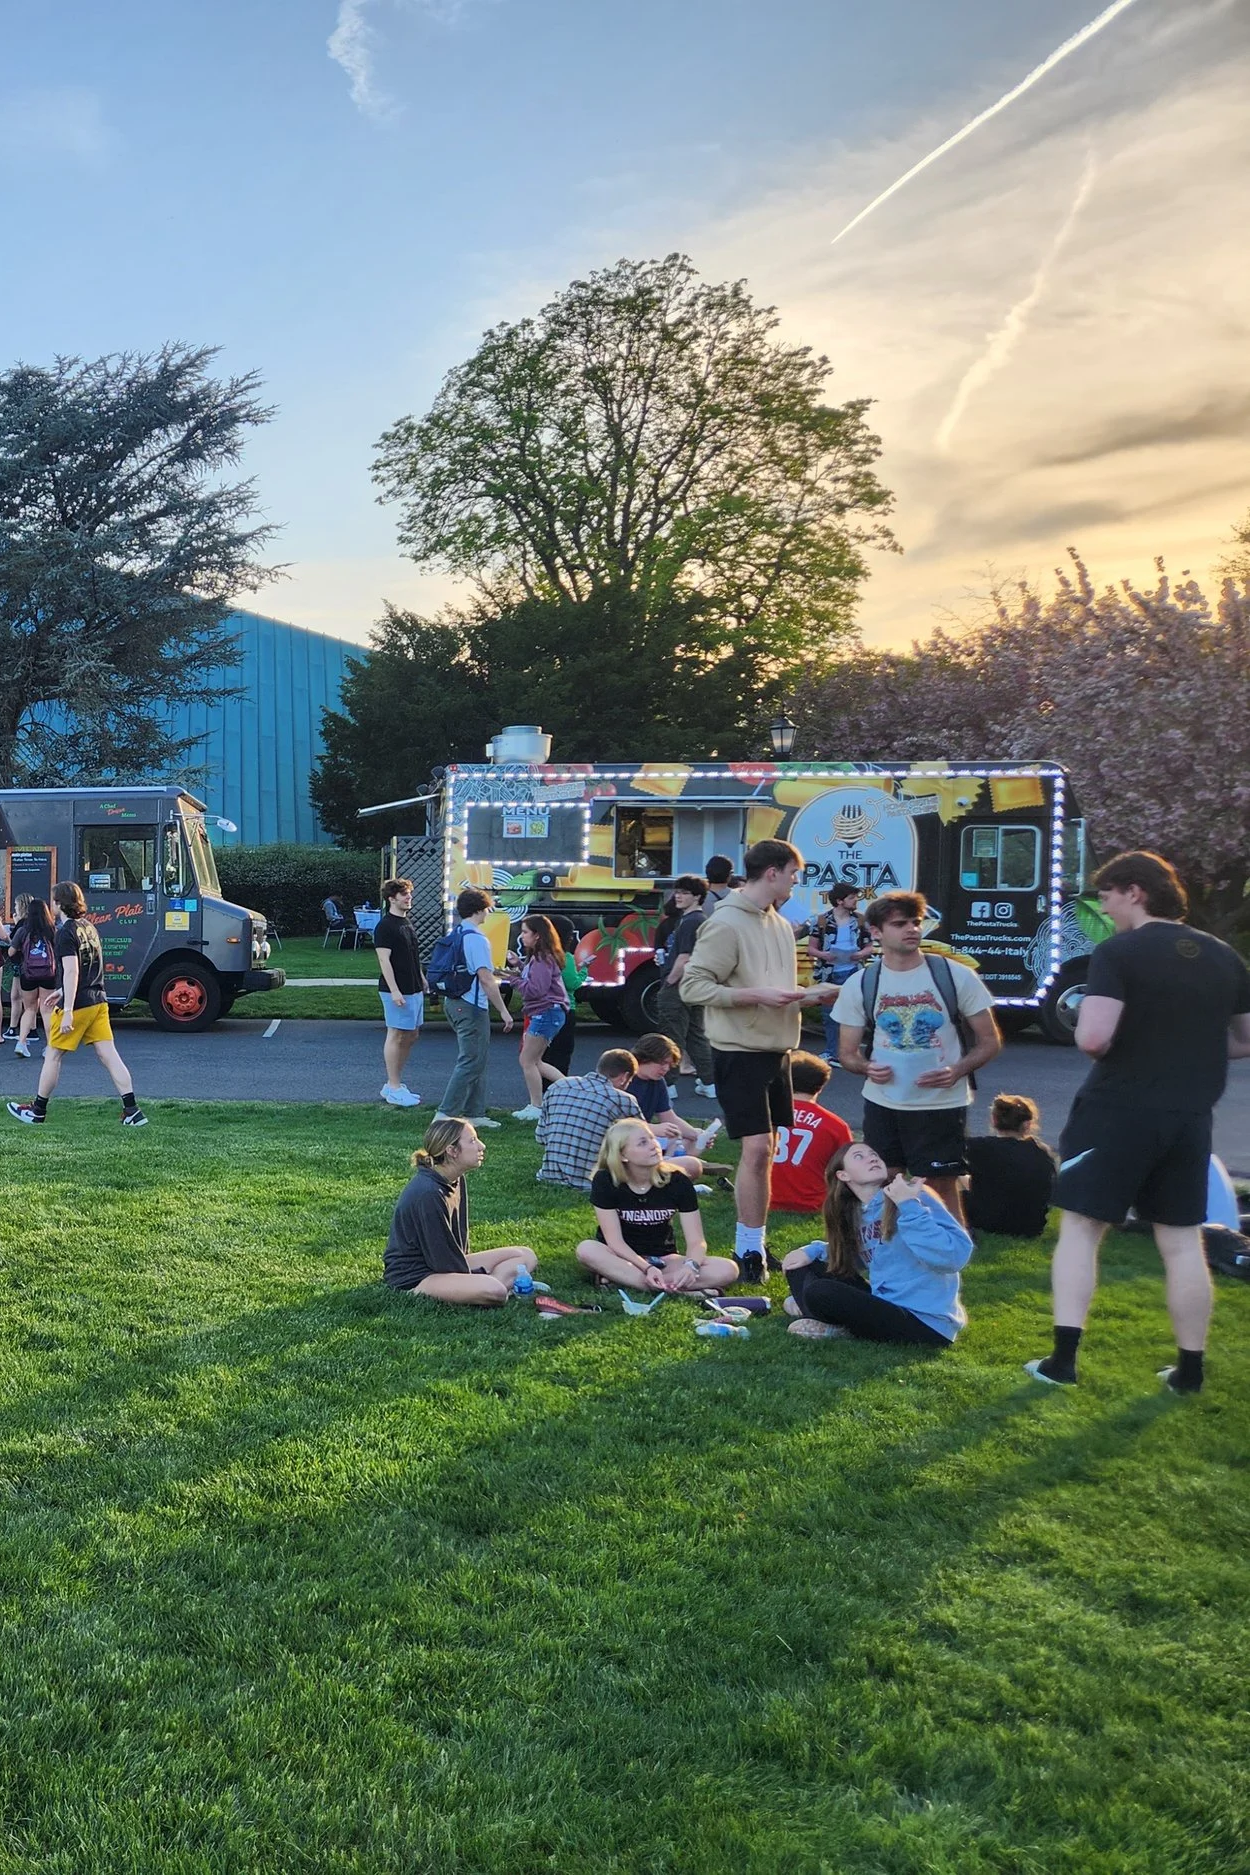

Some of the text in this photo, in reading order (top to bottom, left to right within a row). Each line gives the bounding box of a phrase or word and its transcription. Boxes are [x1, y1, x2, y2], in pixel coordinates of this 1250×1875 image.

[502, 806, 550, 815] MENU
[838, 850, 862, 860] THE
[801, 861, 901, 888] PASTA
[819, 887, 877, 904] TCK
[115, 904, 144, 919] Plate
[966, 920, 1018, 928] ThePastaTrucks
[951, 933, 1031, 942] ThePastaTrucks.com
[951, 946, 1029, 957] 1-844-44-Italy
[773, 1126, 814, 1166] 37
[621, 1208, 676, 1222] INGANORE
